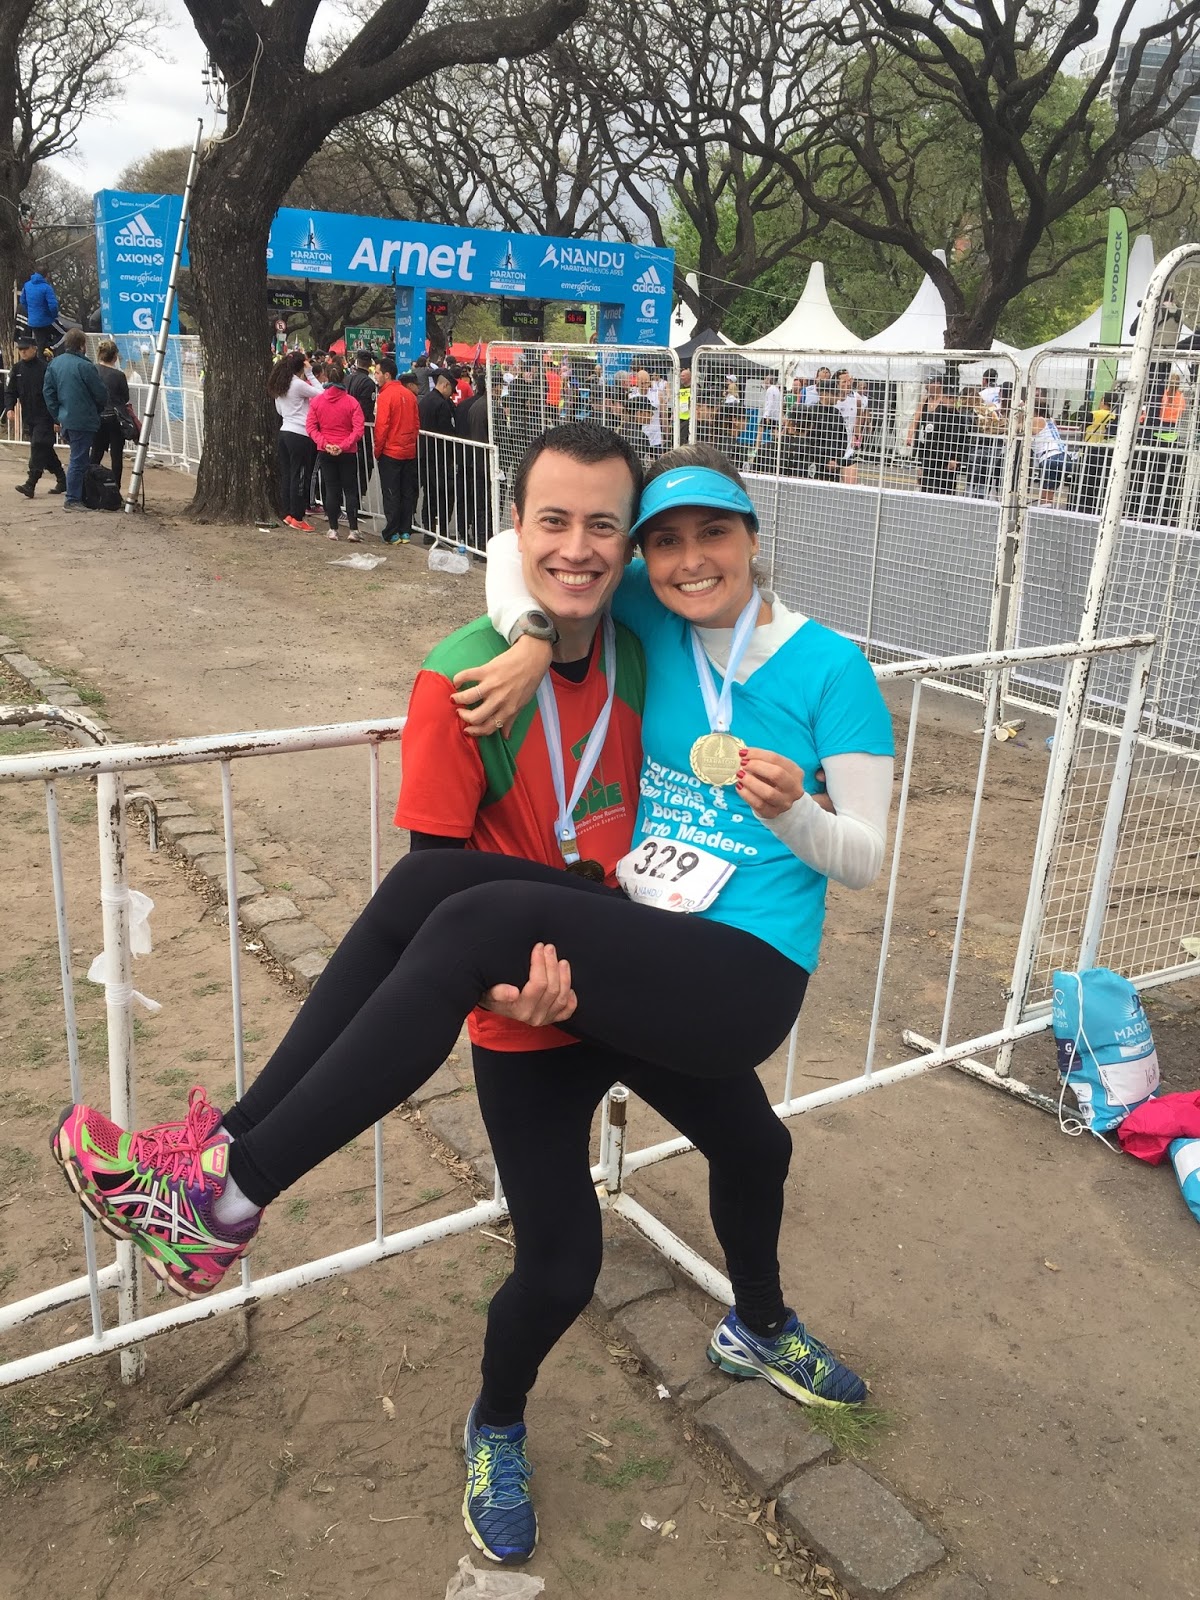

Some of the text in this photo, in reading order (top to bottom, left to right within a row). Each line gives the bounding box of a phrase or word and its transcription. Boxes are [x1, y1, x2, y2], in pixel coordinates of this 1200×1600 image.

[114, 235, 163, 248] adidas
[116, 253, 152, 264] AXION
[291, 250, 332, 261] MARATON
[348, 237, 477, 281] Arnet
[120, 273, 163, 283] emergencias
[490, 270, 526, 279] MARATON
[560, 282, 601, 292] emergencias
[632, 282, 666, 295] adidas
[118, 291, 167, 303] SONY
[592, 812, 604, 822] One
[604, 806, 626, 817] Running
[651, 801, 693, 824] Boca
[676, 823, 758, 857] Madero
[634, 841, 700, 883] 329
